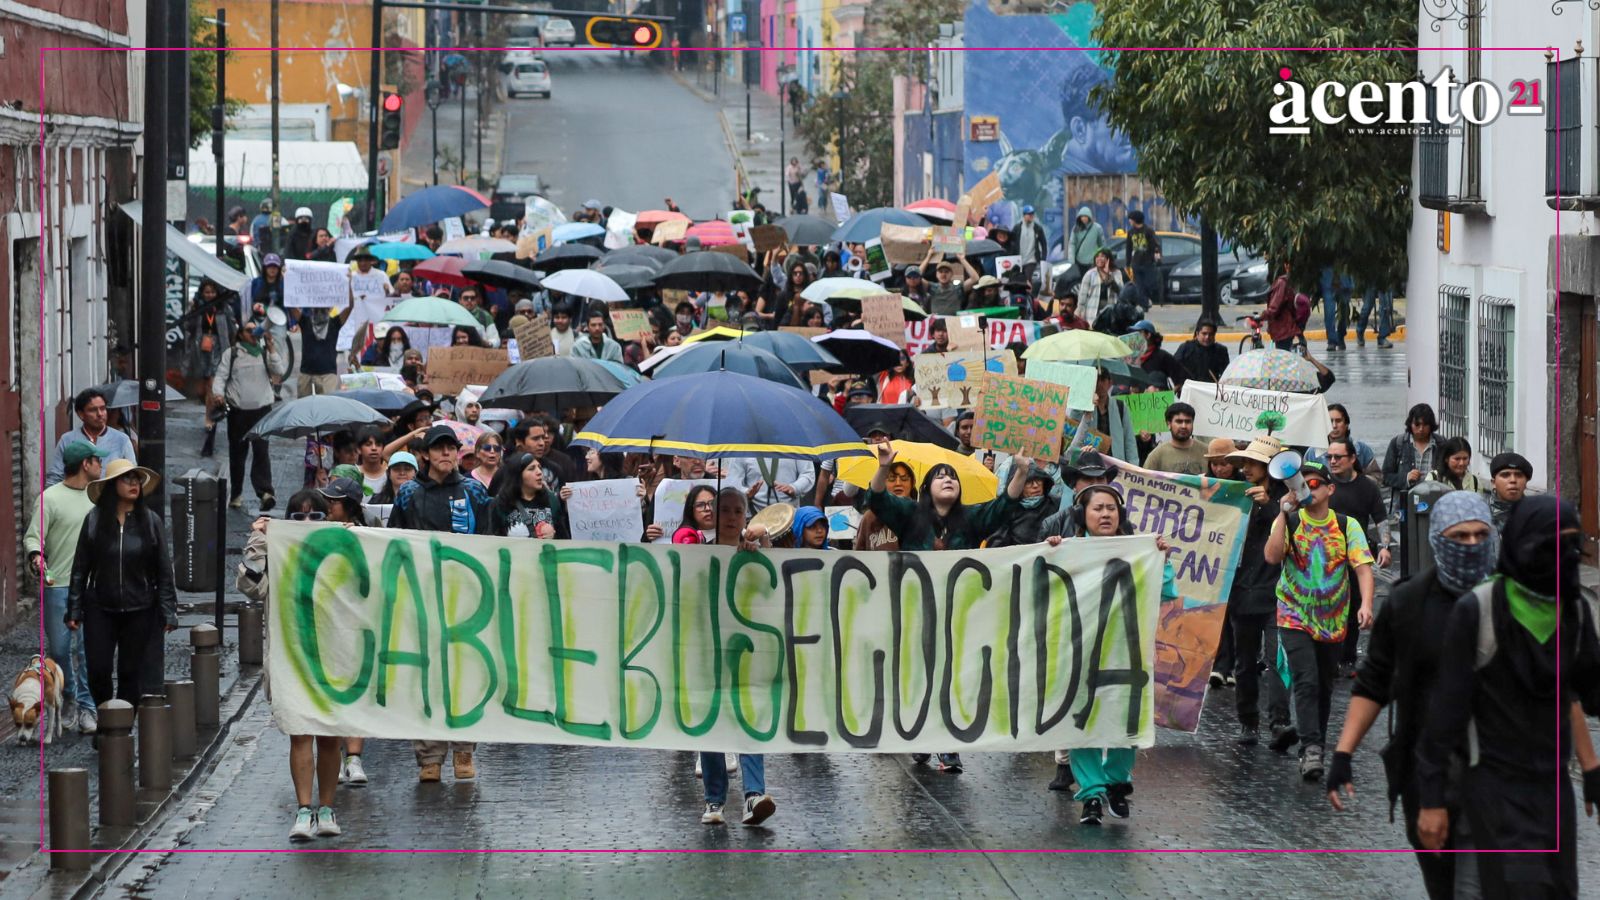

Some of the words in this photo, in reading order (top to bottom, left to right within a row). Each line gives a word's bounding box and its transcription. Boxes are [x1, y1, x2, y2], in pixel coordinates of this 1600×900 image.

[983, 431, 1053, 457] PLANETA
[1124, 471, 1145, 486] POR
[1147, 479, 1177, 494] AMOR
[1179, 487, 1194, 498] AL
[580, 487, 598, 499] NO
[604, 487, 619, 497] AL
[576, 518, 633, 531] QUEREMOS
[1208, 531, 1226, 545] DE
